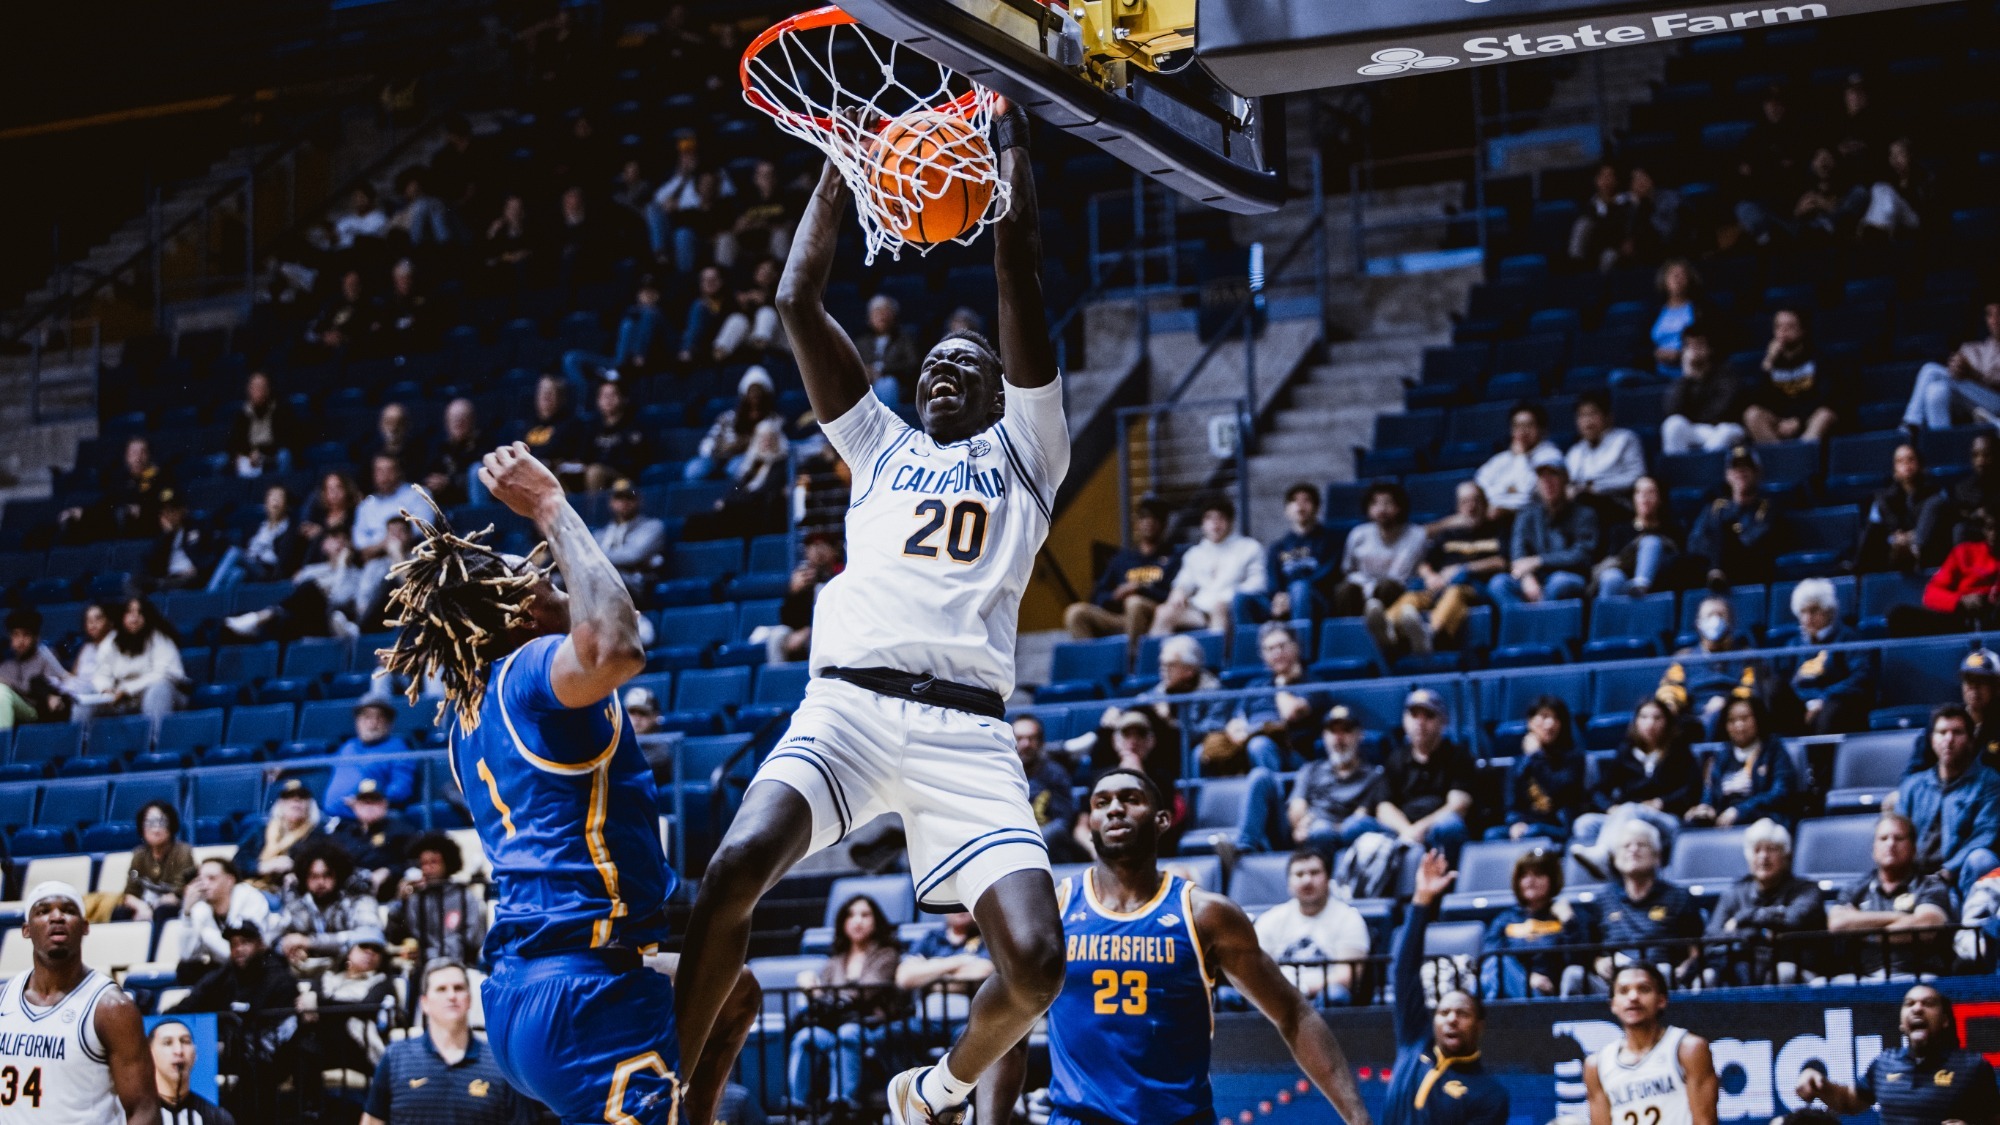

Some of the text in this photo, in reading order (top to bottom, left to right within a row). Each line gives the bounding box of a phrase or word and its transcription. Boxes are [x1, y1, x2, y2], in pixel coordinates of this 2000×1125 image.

[1463, 4, 1828, 62] State Farm
[901, 498, 990, 565] 20
[476, 756, 517, 840] 1
[1066, 934, 1175, 964] BAKERSFIELD
[1092, 969, 1148, 1015] 23
[0, 1032, 65, 1060] ALIFORNIA
[0, 1064, 42, 1108] 34
